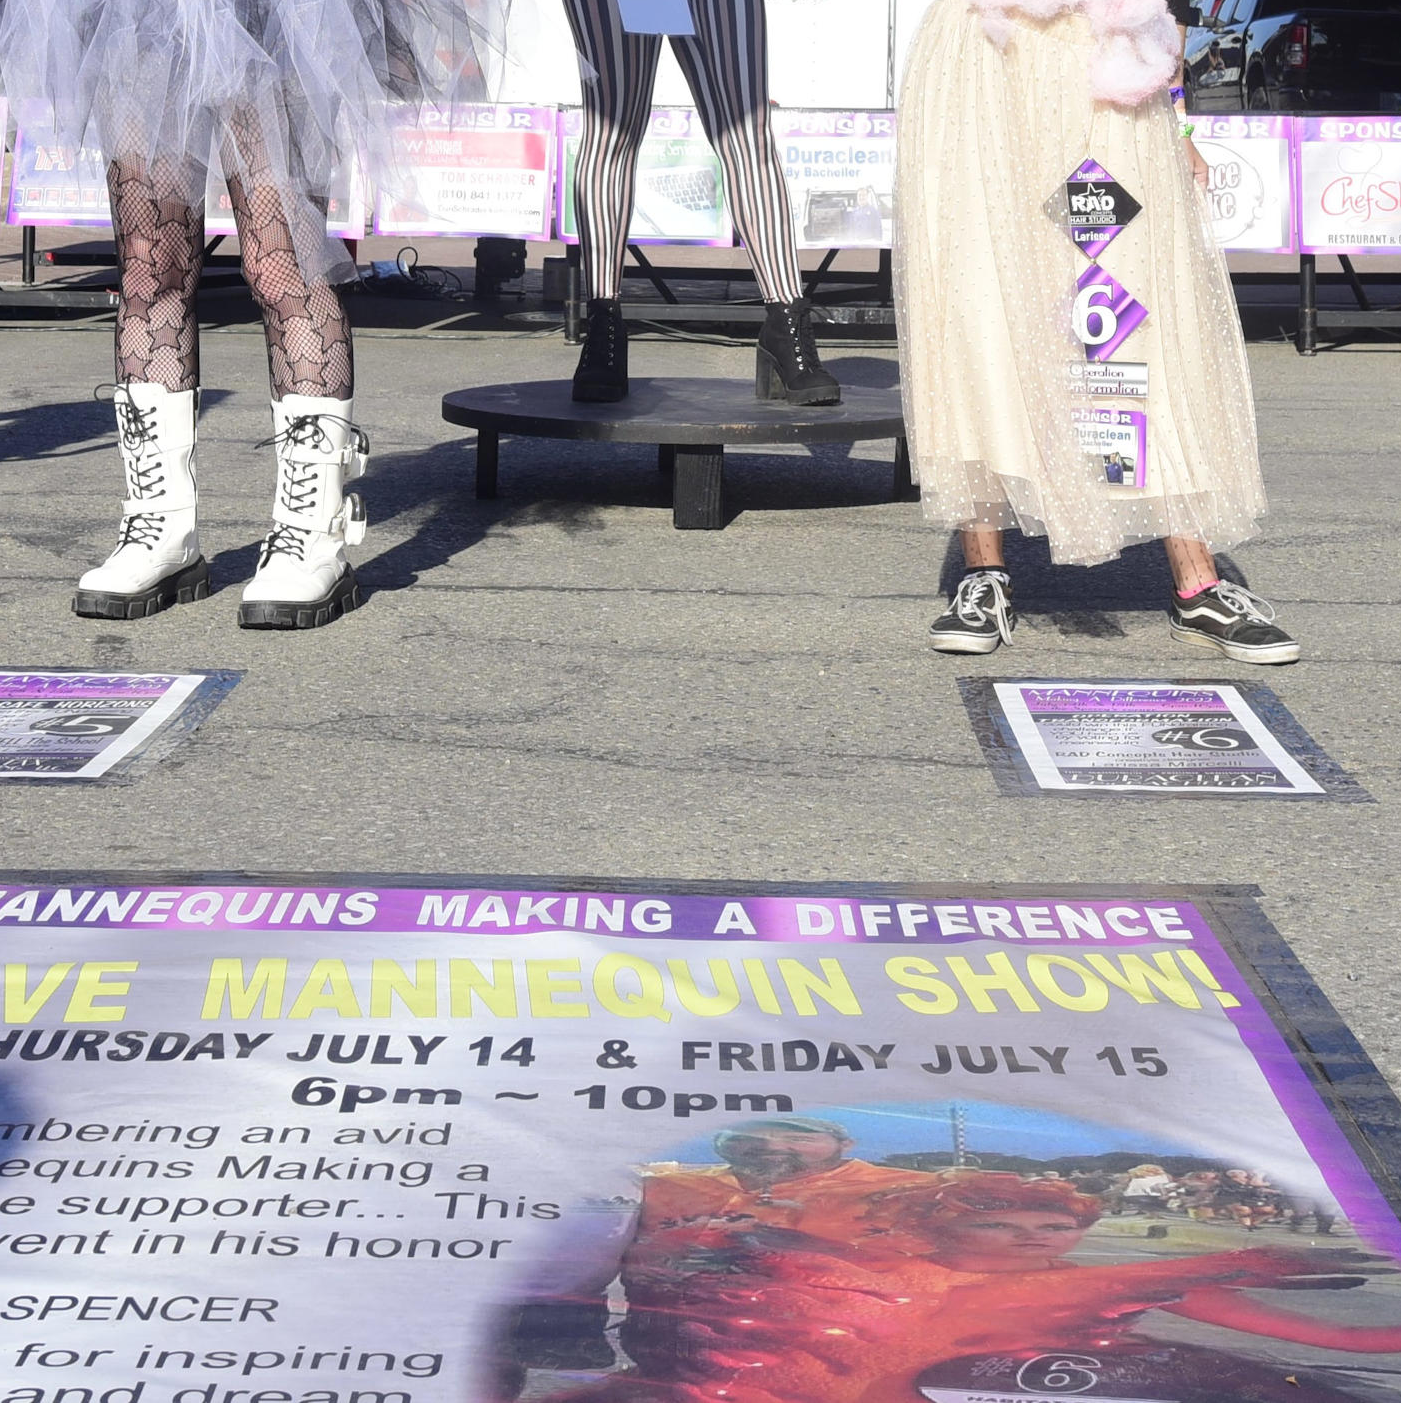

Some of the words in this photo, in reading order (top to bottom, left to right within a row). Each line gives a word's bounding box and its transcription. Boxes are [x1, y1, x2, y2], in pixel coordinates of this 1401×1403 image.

[786, 146, 893, 164] Duraclean
[786, 167, 800, 180] By
[1077, 170, 1106, 180] Designer
[1071, 195, 1115, 212] RAD
[1070, 216, 1087, 224] HAIR
[1089, 216, 1116, 224] STUDIO
[1075, 230, 1110, 242] Larissa
[1328, 234, 1386, 245] RESTAURANT
[1389, 236, 1397, 244] &
[1072, 284, 1117, 345] 6
[1069, 365, 1124, 381] Operation
[52, 700, 158, 708] HORIZONS
[36, 714, 132, 735] #5
[1160, 728, 1240, 749] #6
[1071, 774, 1277, 782] DURACLEAN
[417, 894, 673, 933] MAKING
[714, 902, 757, 935] A
[797, 903, 1193, 941] DIFFERENCE
[200, 952, 863, 1024] MANNEQUIN
[885, 948, 1241, 1015] SHOW!
[287, 1034, 448, 1066] JULY
[469, 1037, 536, 1068] 14
[596, 1039, 638, 1070] &
[681, 1040, 896, 1073] FRIDAY
[922, 1044, 1073, 1075] JULY
[1096, 1046, 1169, 1077] 15
[292, 1076, 462, 1113] 6pm
[574, 1084, 793, 1117] 10pm
[240, 1124, 311, 1145] an
[333, 1122, 453, 1146] avid
[217, 1156, 434, 1188] Making
[456, 1161, 490, 1182] a
[57, 1193, 405, 1223] supporter...
[434, 1192, 561, 1221] This
[132, 1230, 185, 1255] in
[210, 1230, 300, 1257] his
[325, 1231, 512, 1259] honor
[0, 1295, 279, 1323] SPENCER
[15, 1343, 116, 1368] for
[135, 1344, 444, 1378] inspiring
[0, 1380, 146, 1403] and
[172, 1381, 414, 1403] dream
